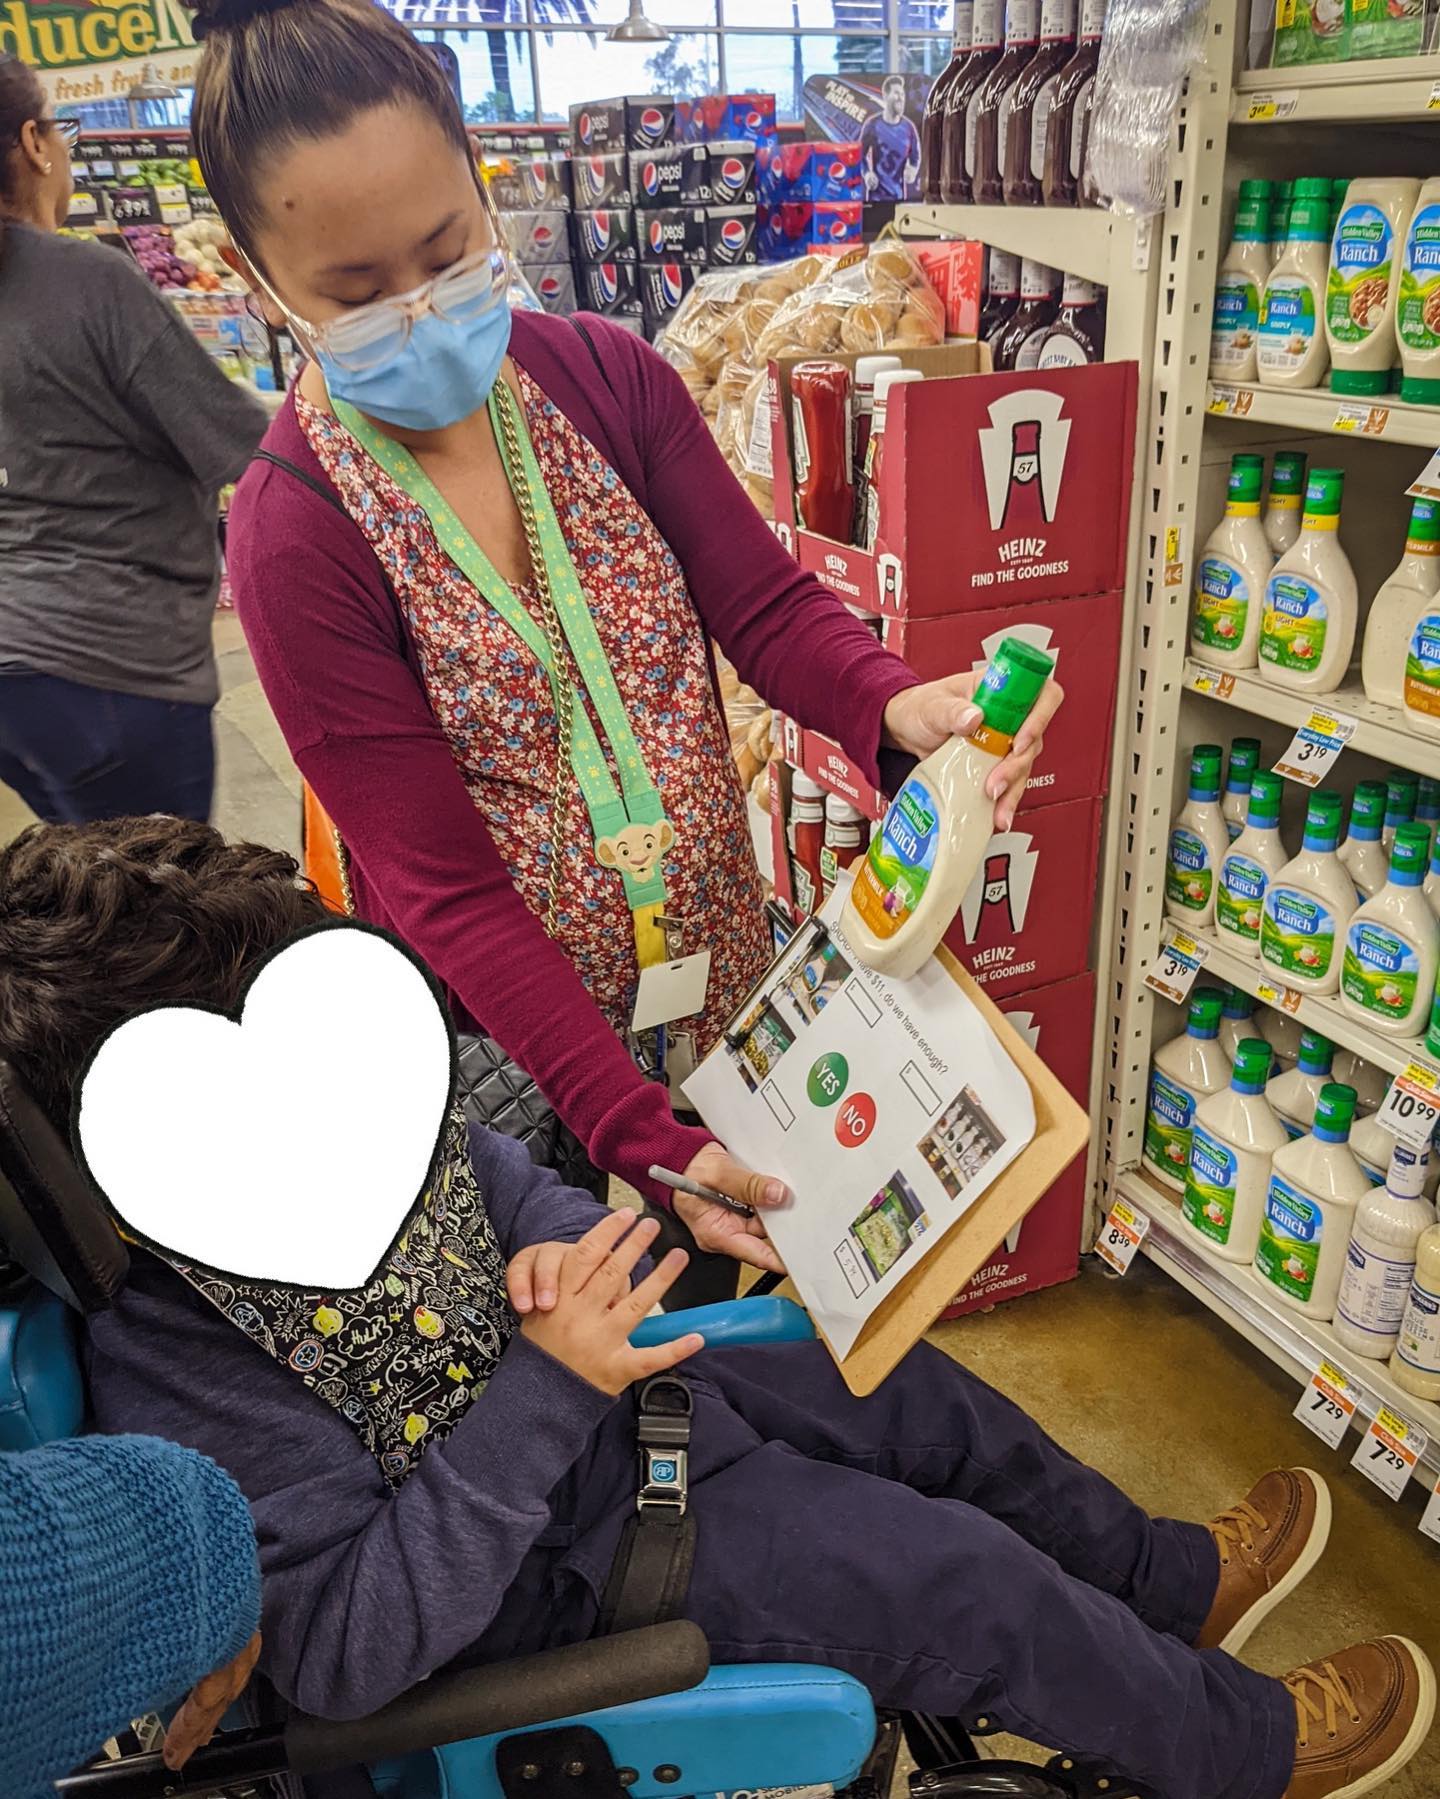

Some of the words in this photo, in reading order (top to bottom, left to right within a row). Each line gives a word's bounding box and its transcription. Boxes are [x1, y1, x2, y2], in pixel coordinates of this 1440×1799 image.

[56, 73, 104, 101] fresh
[824, 91, 868, 123] INSPIRE
[591, 112, 609, 130] pepsi
[657, 162, 683, 185] pepsi
[662, 222, 686, 243] pepsi
[1340, 243, 1379, 262] Ranch
[1216, 298, 1243, 311] Ranch
[1270, 302, 1298, 316] Ranch
[1017, 461, 1034, 475] 57
[998, 537, 1047, 563] HEINZ
[824, 554, 848, 577] HEINZ
[971, 572, 994, 588] FIND
[995, 568, 1015, 584] THE
[1017, 561, 1070, 580] GOODNESS
[1203, 579, 1228, 598] Ranch
[1275, 595, 1304, 616] Ranch
[1275, 614, 1295, 627] LIGHT
[827, 755, 848, 778] HEINZ
[911, 809, 928, 836] Valley
[888, 814, 919, 861] Ranch
[1173, 847, 1200, 868] Ranch
[988, 884, 1003, 898] 57
[1228, 874, 1259, 897] Ranch
[1277, 907, 1312, 932] Ranch
[971, 946, 1016, 969] HEINZ
[1359, 942, 1395, 969] Ranch
[989, 960, 1036, 981] GOODNESS
[883, 993, 895, 1007] do
[892, 1004, 904, 1020] we
[901, 1014, 920, 1040] have
[916, 1037, 949, 1076] enough?
[816, 1062, 841, 1096] YES
[842, 1105, 866, 1137] NO
[1153, 1095, 1185, 1125] Ranch
[1192, 1150, 1225, 1184] Ranch
[1270, 1202, 1308, 1238] Ranch
[969, 1287, 984, 1300] THE
[984, 1273, 1029, 1293] GOODNESS
[970, 1264, 1009, 1286] HEINZ
